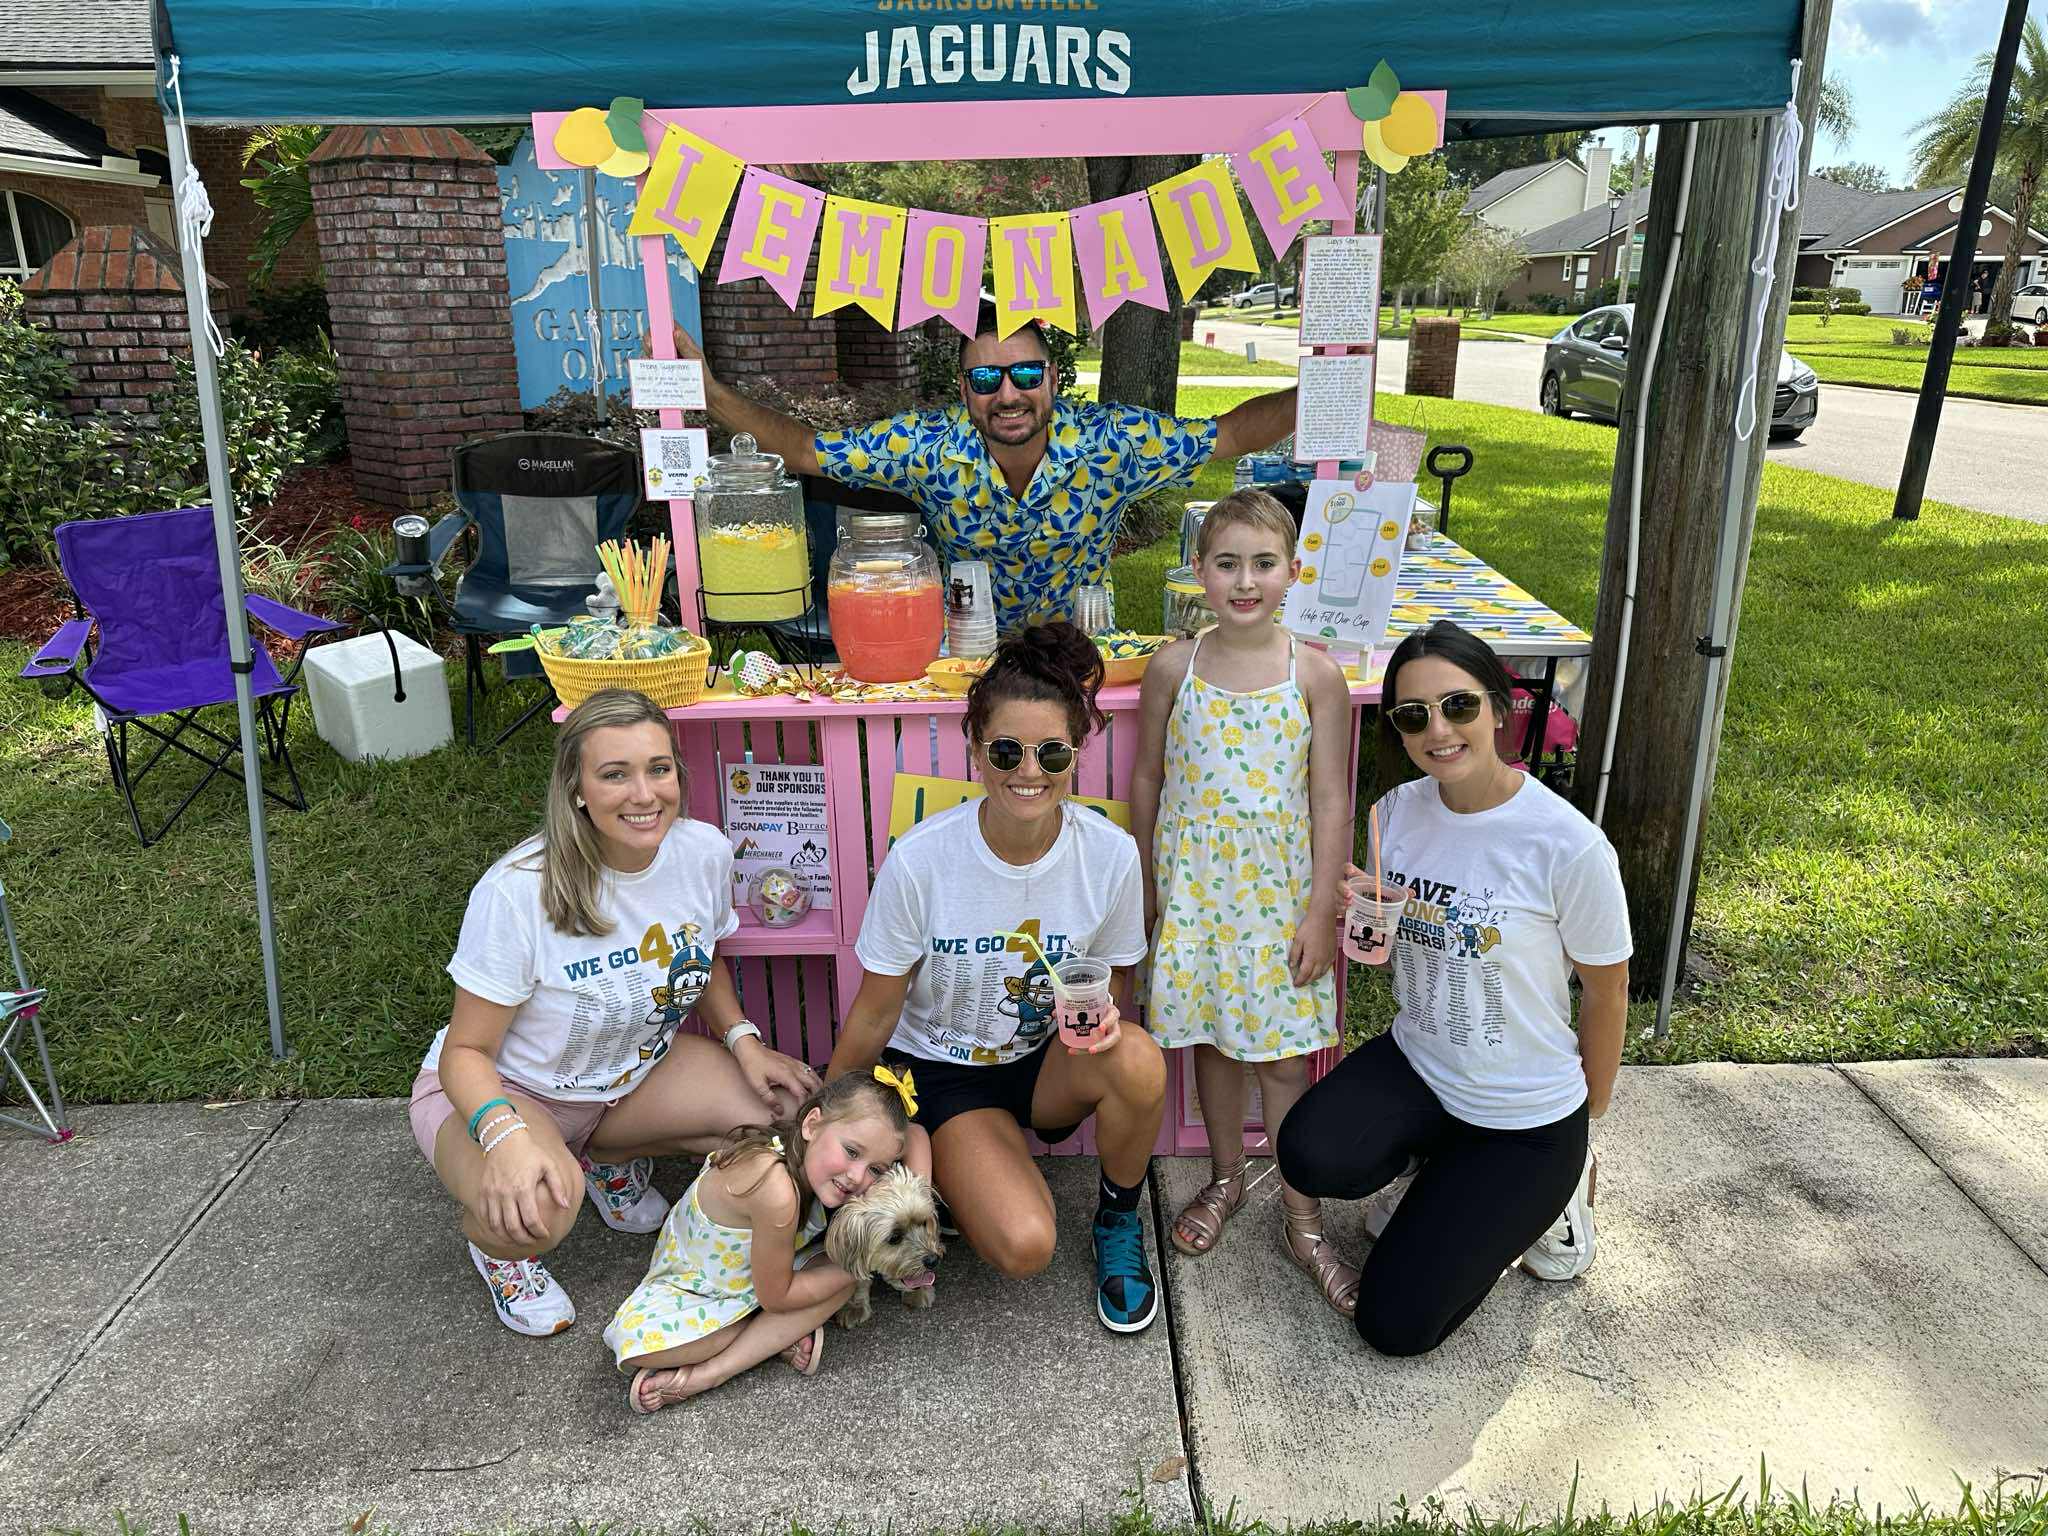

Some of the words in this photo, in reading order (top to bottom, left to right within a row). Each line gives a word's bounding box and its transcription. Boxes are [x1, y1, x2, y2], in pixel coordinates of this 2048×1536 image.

[847, 23, 1131, 96] JAGUARS
[654, 128, 1324, 311] LEMONADE
[531, 460, 574, 469] MAGELLAN
[1300, 609, 1317, 624] Help
[1320, 611, 1335, 623] Fill
[1335, 611, 1350, 624] Our
[1353, 614, 1370, 630] Cup
[760, 771, 790, 781] THANK
[793, 772, 811, 782] YOU
[814, 773, 825, 783] TO
[756, 782, 774, 793] OUR
[777, 783, 826, 794] SPONSORS
[730, 822, 783, 832] SIGNAPAY
[787, 821, 828, 835] Barrac
[813, 885, 832, 894] Family
[932, 936, 968, 955] WE
[975, 936, 1004, 953] GO
[1006, 919, 1044, 962] 4
[1046, 934, 1067, 951] IT
[563, 957, 603, 982] WE
[608, 947, 639, 969] GO
[639, 922, 675, 969] 4
[949, 1045, 970, 1061] ON
